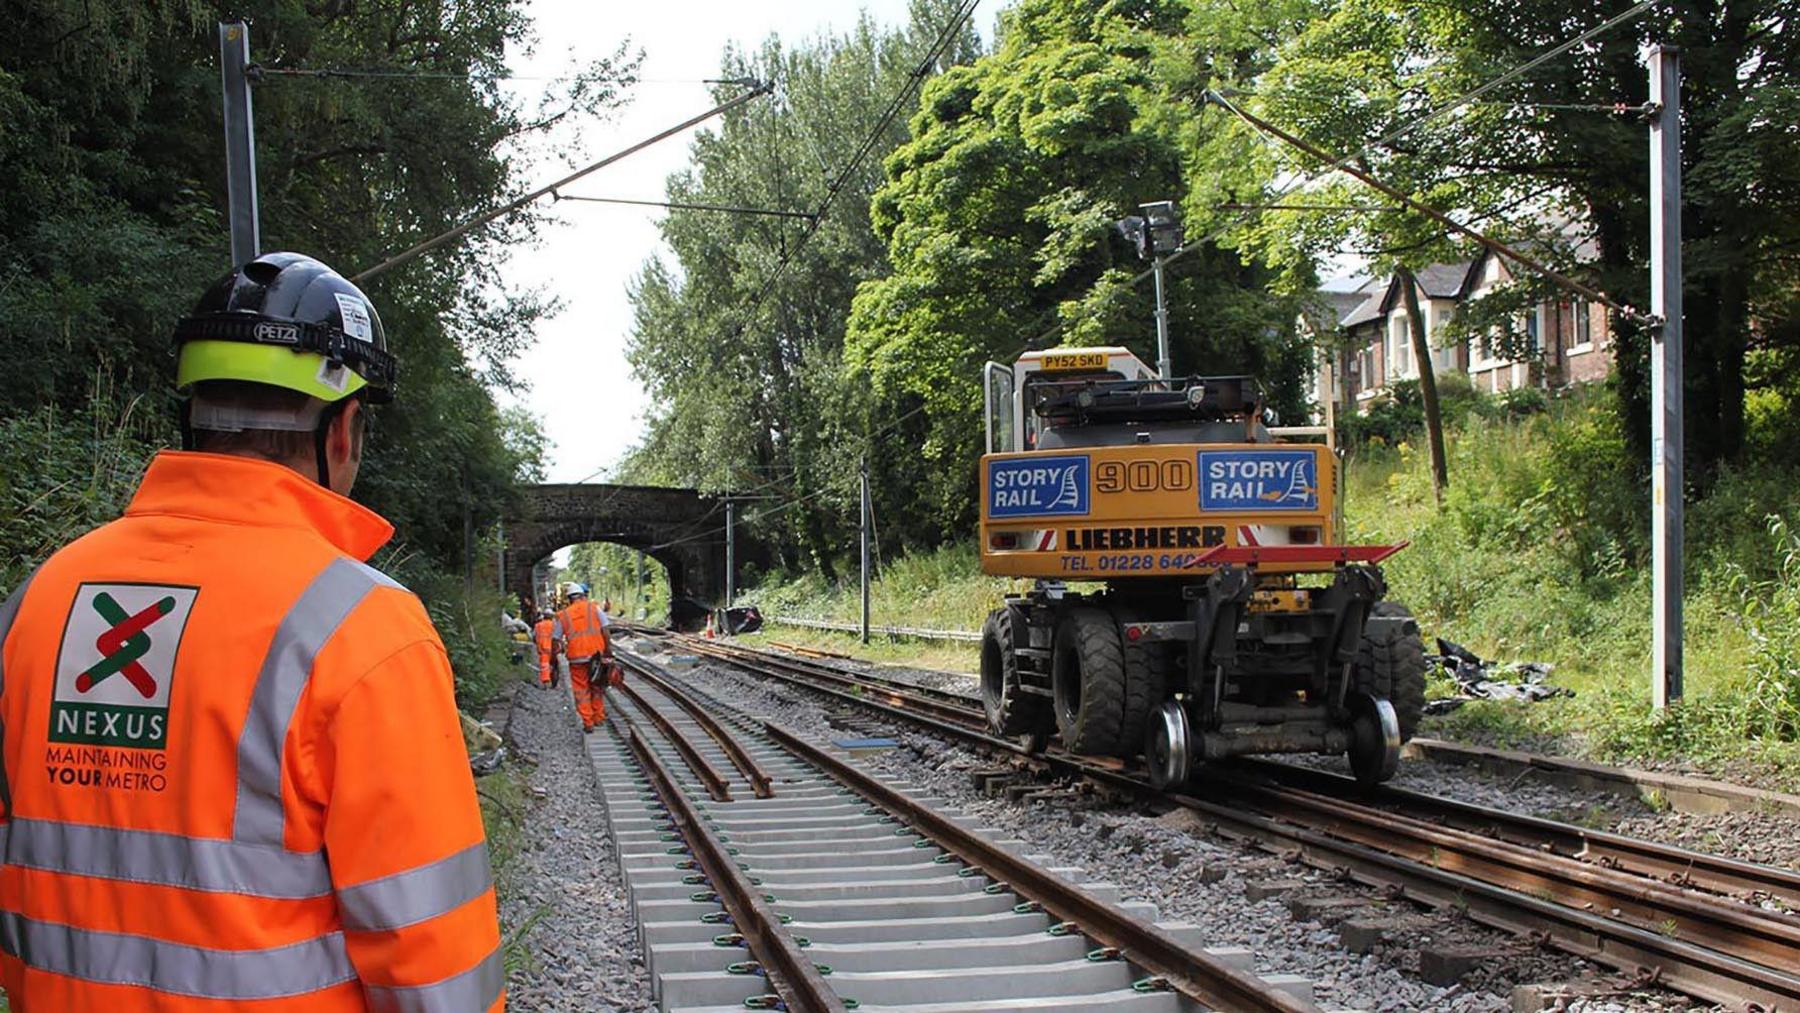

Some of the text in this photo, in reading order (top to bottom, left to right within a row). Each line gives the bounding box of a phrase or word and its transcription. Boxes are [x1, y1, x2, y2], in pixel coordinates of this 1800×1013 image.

[257, 323, 299, 342] PETZL
[1045, 354, 1077, 367] PY52
[995, 468, 1062, 488] STORY
[1096, 458, 1193, 494] 900
[1209, 461, 1291, 479] STORY
[995, 489, 1042, 508] RAIL
[1066, 525, 1227, 550] LIEBHERR
[1060, 555, 1094, 571] TEL.
[1098, 554, 1154, 571] 01228
[57, 708, 164, 740] NEXUS
[46, 747, 167, 771] MAINTAINING
